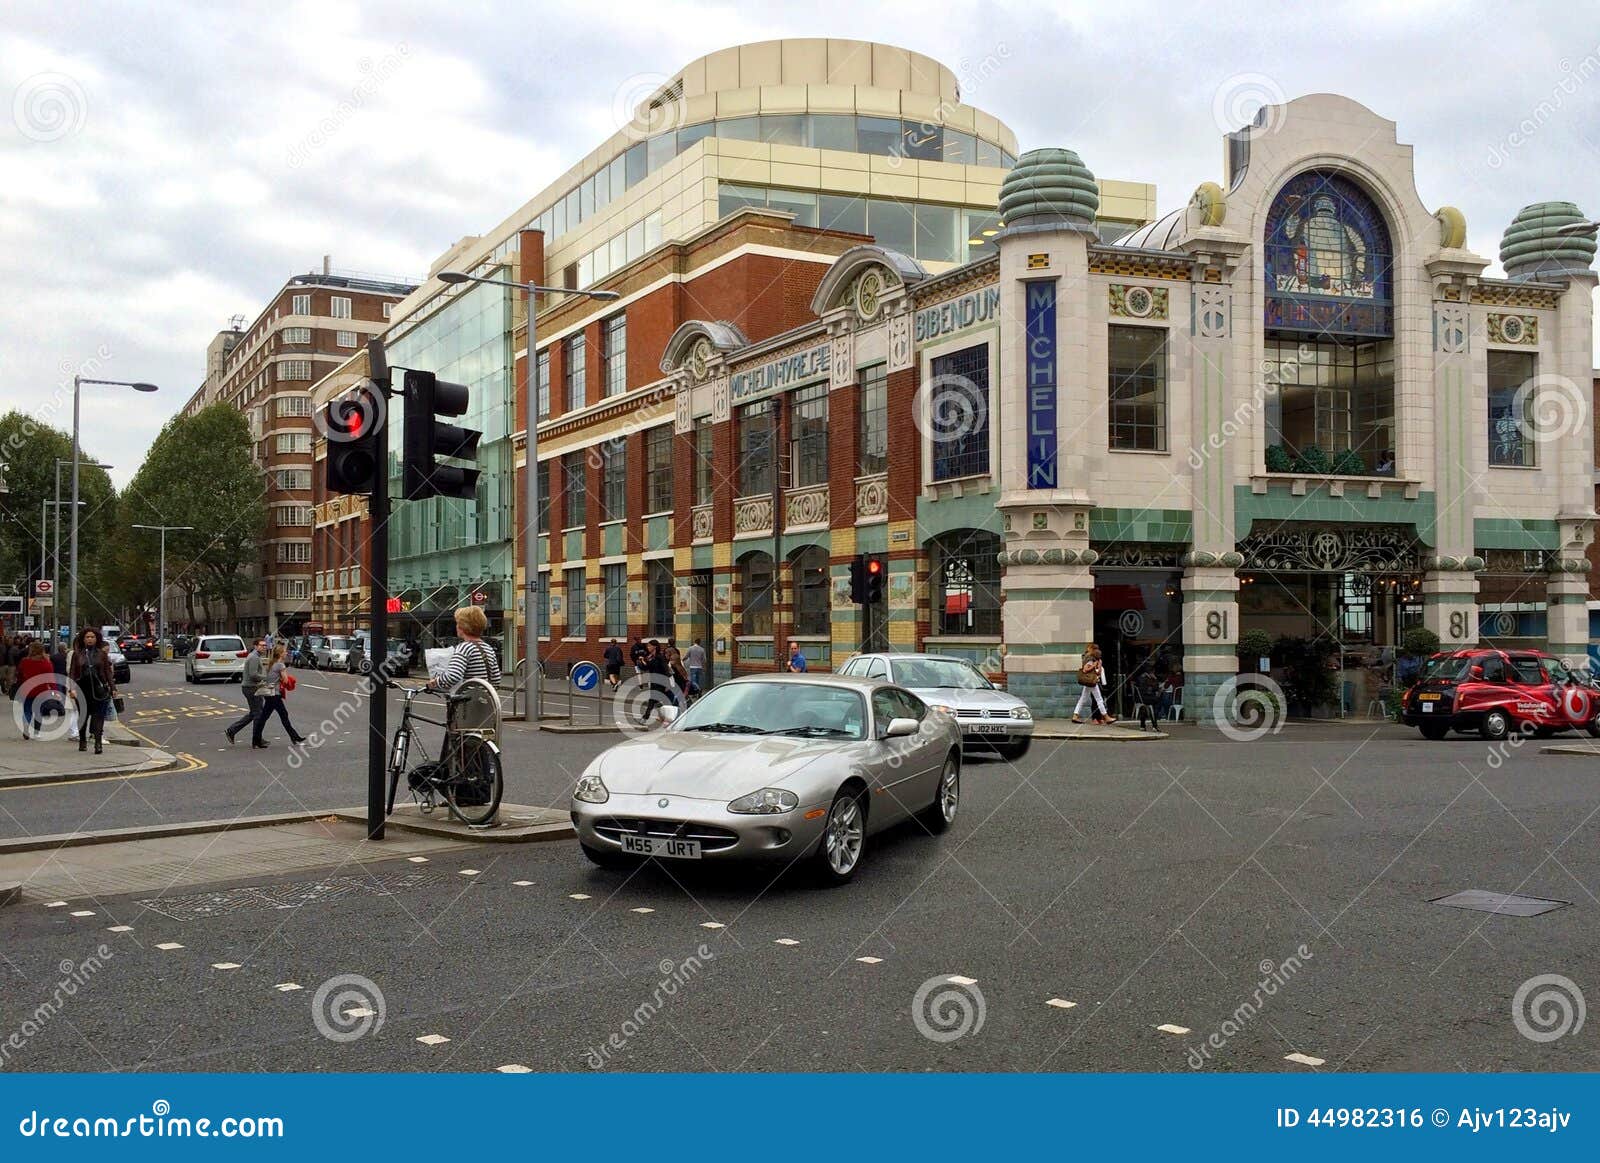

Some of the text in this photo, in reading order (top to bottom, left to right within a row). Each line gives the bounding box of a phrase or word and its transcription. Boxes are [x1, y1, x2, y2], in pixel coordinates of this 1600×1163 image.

[915, 286, 1000, 342] BIBENDUM
[1030, 287, 1055, 485] MICHELIN
[1206, 610, 1228, 639] 81
[1449, 610, 1469, 639] 81
[625, 837, 695, 857] M55 URT
